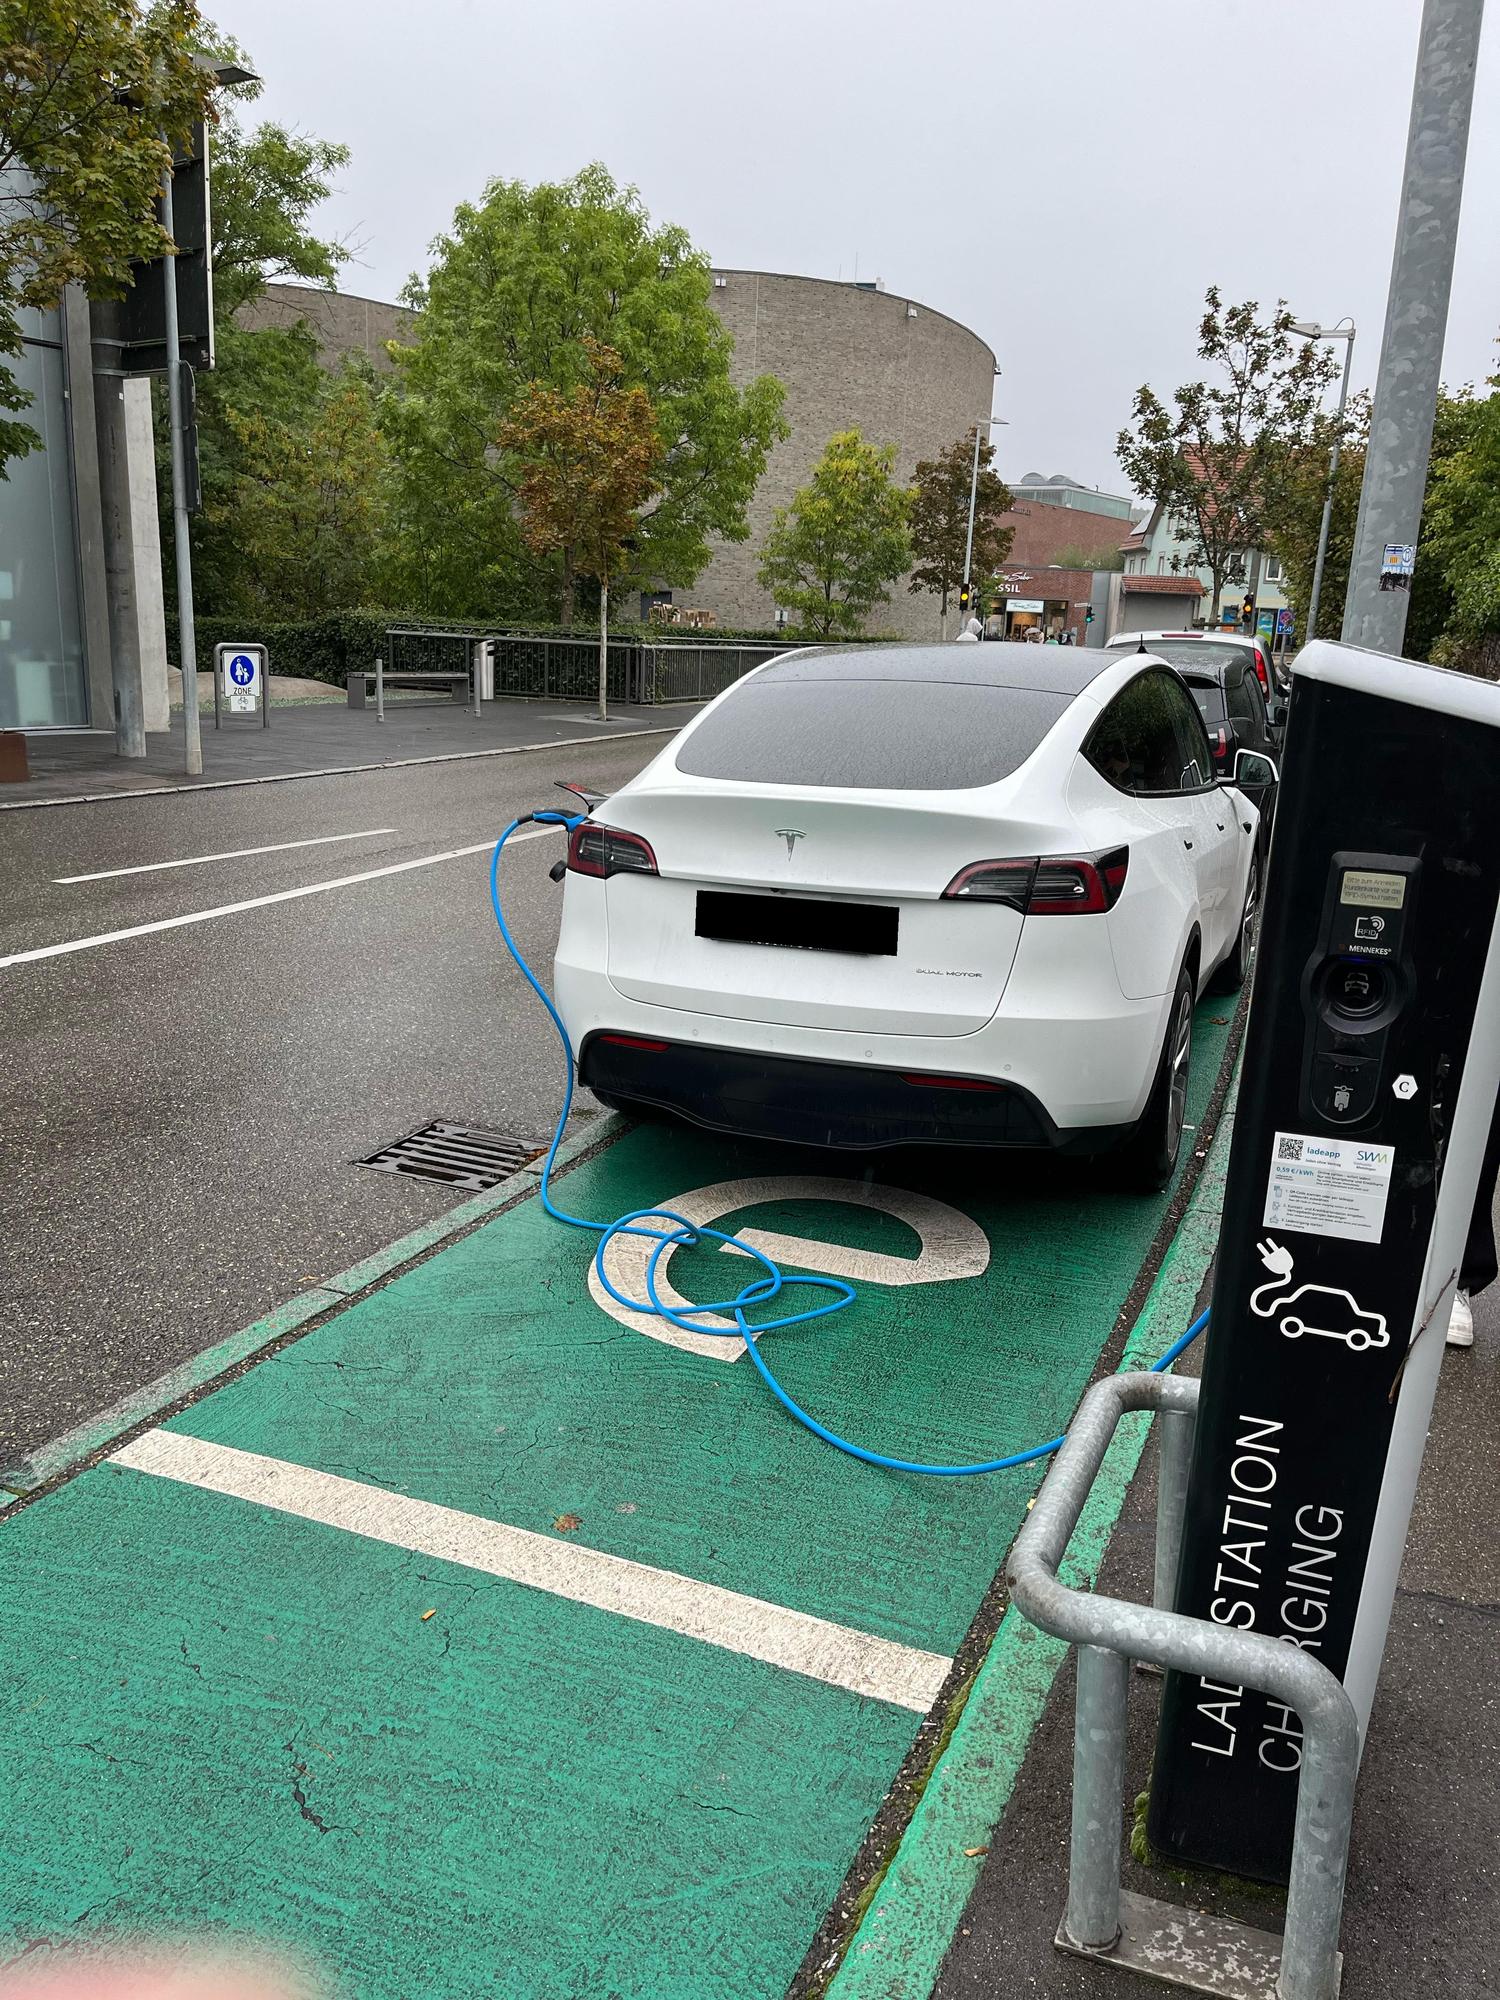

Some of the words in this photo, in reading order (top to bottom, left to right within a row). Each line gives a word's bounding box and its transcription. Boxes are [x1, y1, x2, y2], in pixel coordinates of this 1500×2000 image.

[233, 687, 252, 695] ZONE
[1357, 928, 1377, 936] RFID
[916, 968, 944, 976] DUAL
[946, 970, 983, 978] MOTOR
[1398, 1081, 1410, 1093] C
[1306, 1146, 1341, 1159] ladeapp
